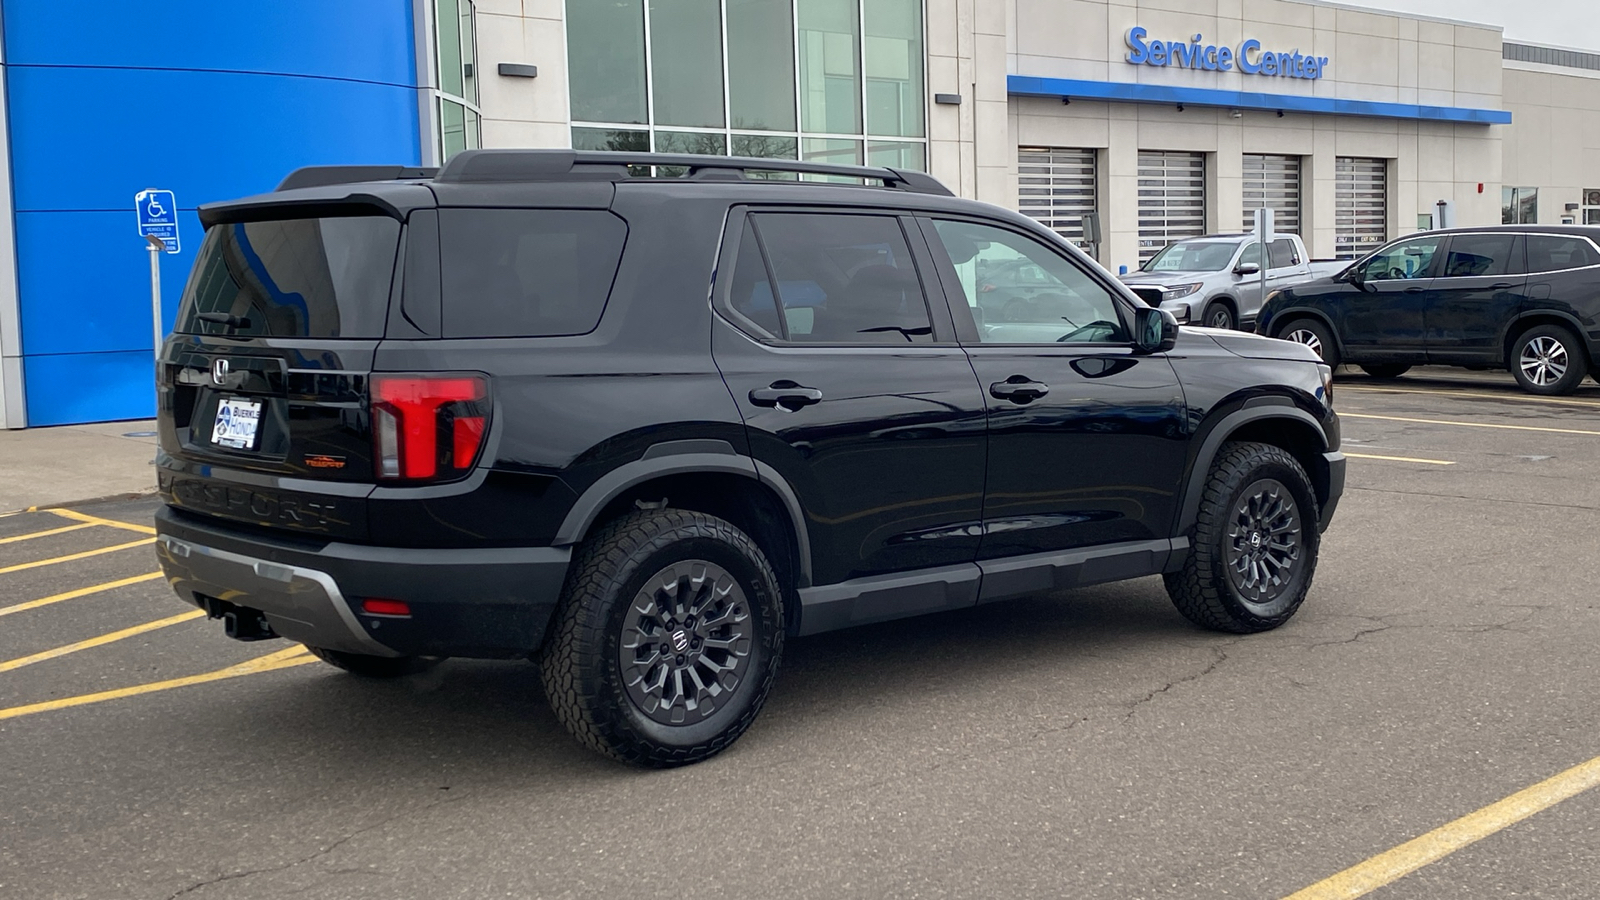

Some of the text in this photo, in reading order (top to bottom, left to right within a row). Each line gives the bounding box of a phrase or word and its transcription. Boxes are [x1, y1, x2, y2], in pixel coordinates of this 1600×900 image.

[1125, 26, 1329, 79] Service Center
[232, 406, 261, 419] BUERKLE
[229, 418, 256, 436] HONDA
